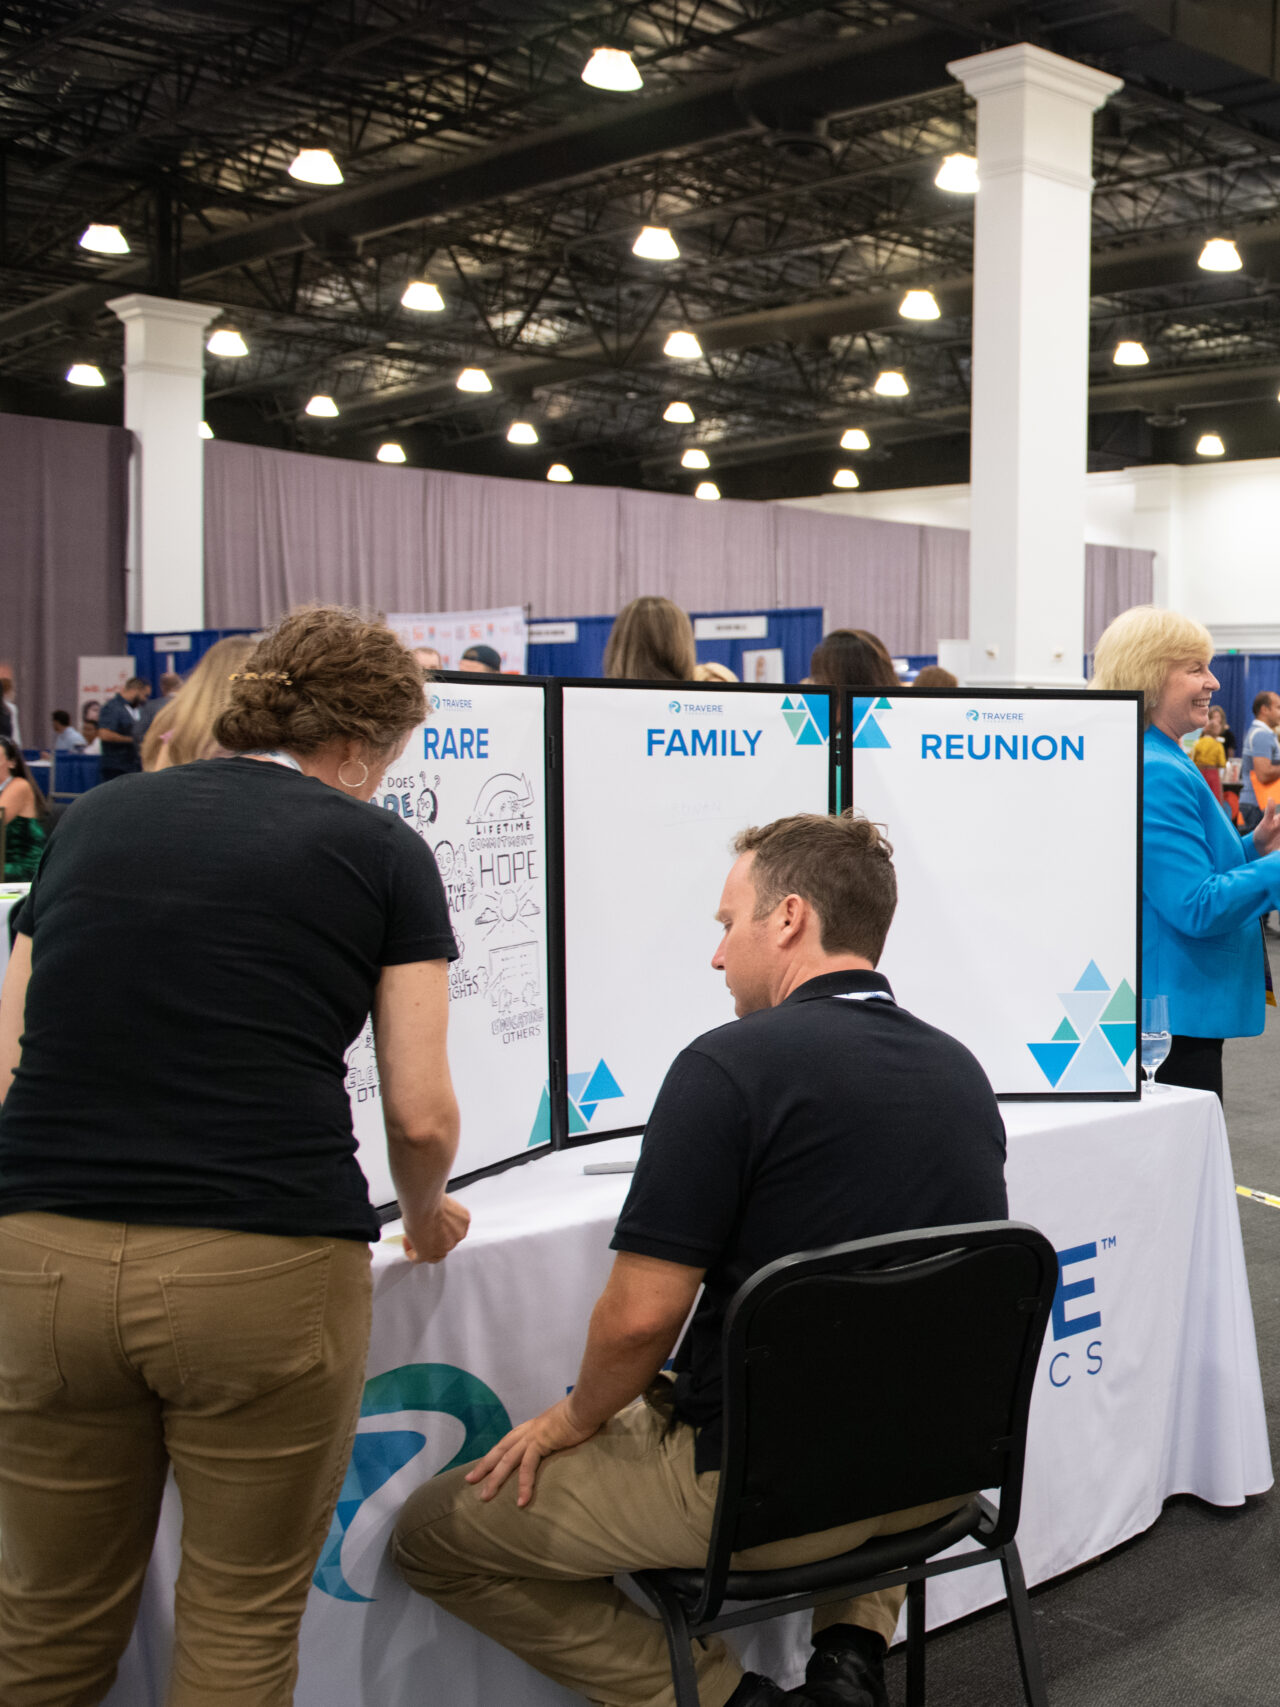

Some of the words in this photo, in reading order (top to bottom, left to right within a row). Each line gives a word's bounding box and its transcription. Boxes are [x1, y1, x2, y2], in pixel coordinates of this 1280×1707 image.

[443, 699, 472, 708] TRAVERE
[684, 704, 723, 713] TRAVERE
[982, 712, 1024, 720] TRAVERE
[424, 728, 489, 760] RARE
[647, 728, 763, 756] FAMILY
[921, 734, 1084, 761] REUNION
[387, 775, 416, 789] DOES
[476, 820, 531, 835] LIFETIME
[468, 834, 535, 852] COMMITMENT
[480, 850, 539, 888] HOPE
[444, 883, 467, 894] TIVE
[502, 1025, 541, 1045] OTHERS
